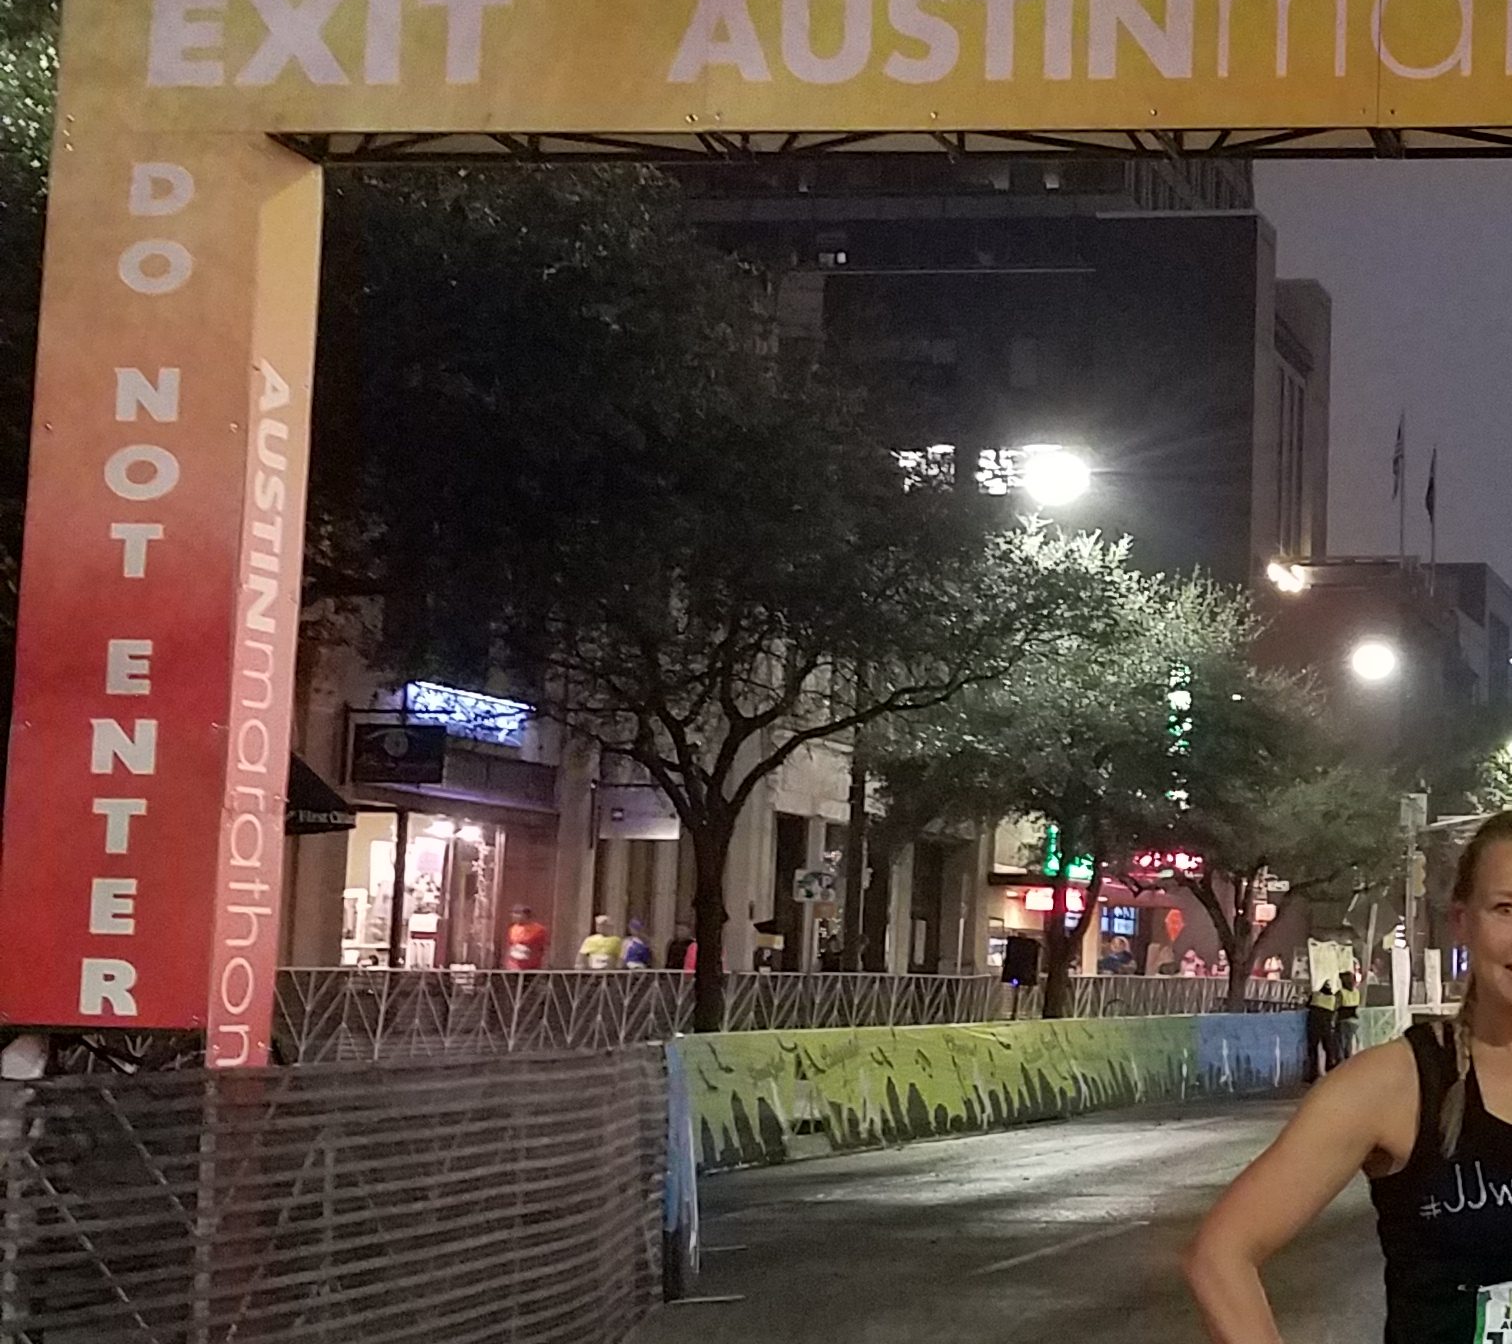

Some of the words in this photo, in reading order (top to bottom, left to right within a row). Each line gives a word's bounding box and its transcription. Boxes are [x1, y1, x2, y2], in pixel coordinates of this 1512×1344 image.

[118, 162, 195, 295] DO
[104, 366, 181, 578] NOT
[79, 639, 157, 1017] ENTER
